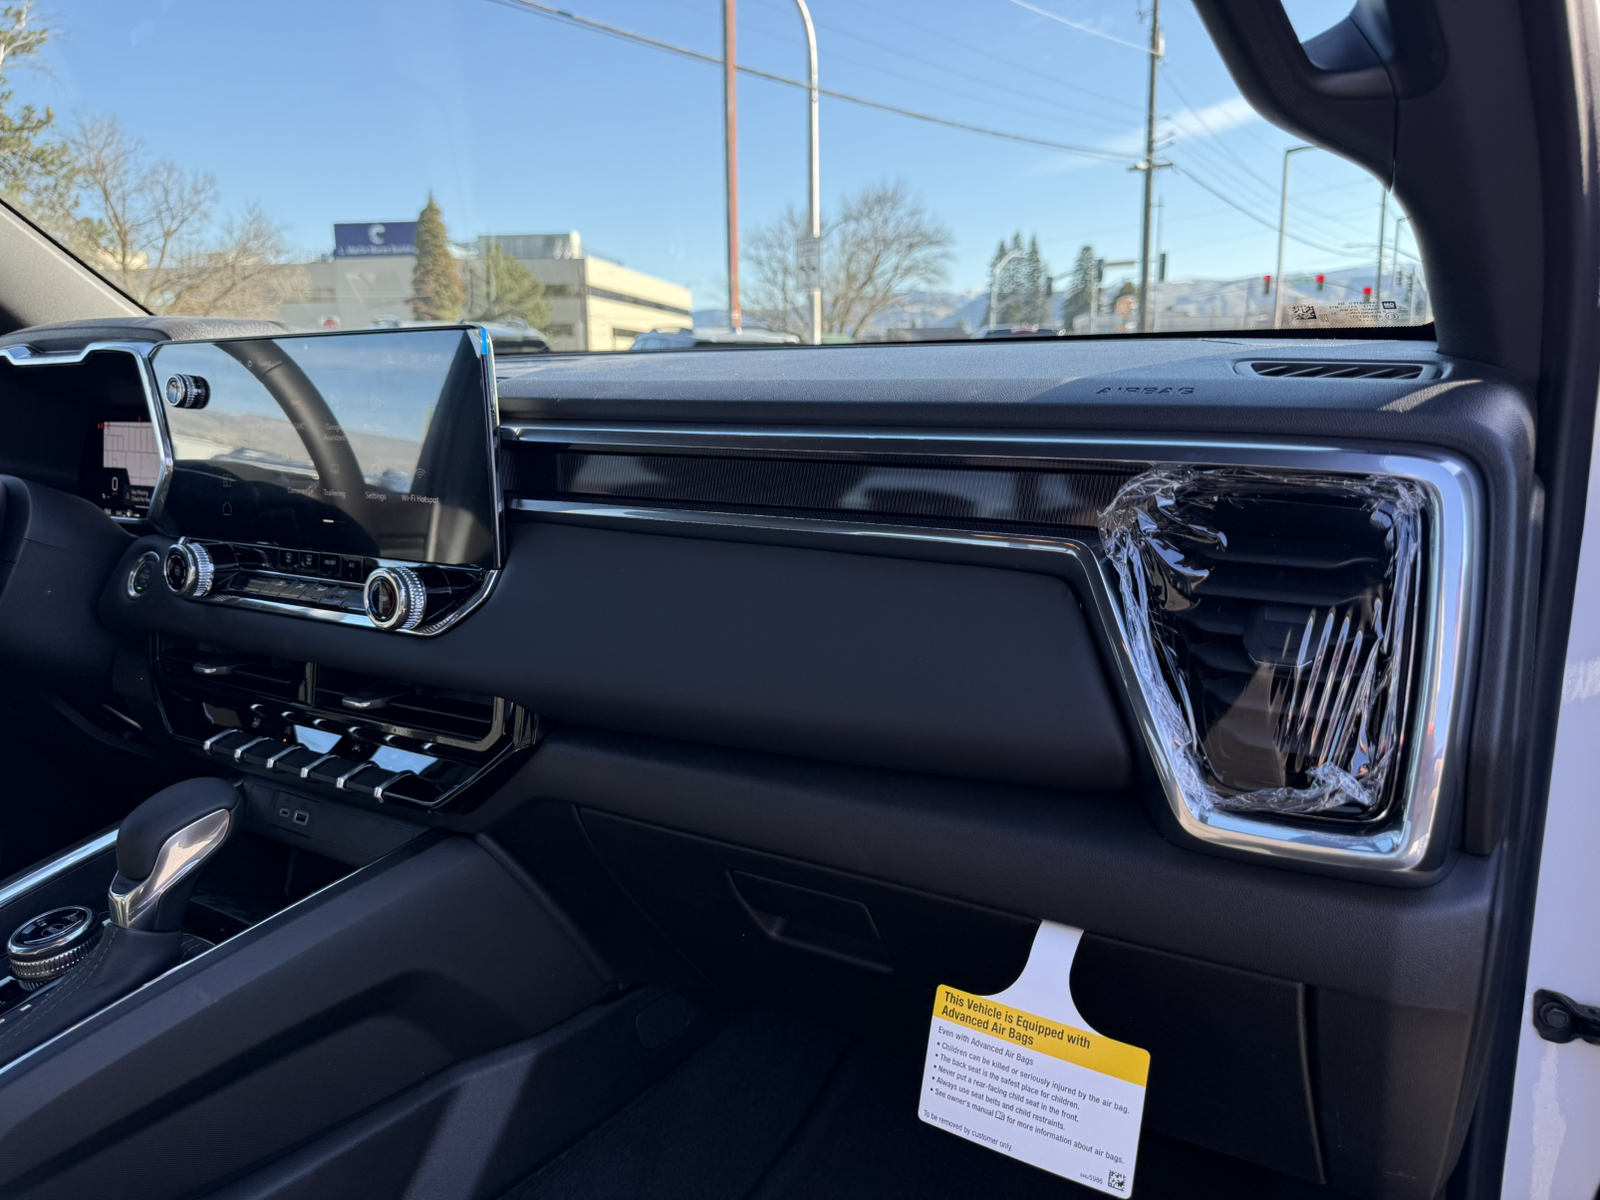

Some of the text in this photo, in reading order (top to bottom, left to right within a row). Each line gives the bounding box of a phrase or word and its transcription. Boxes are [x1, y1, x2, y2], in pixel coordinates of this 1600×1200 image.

[1096, 386, 1195, 395] AIRBAG
[324, 488, 346, 499] Trailering
[365, 491, 387, 502] Settings
[417, 495, 439, 505] Hotspot
[941, 1004, 1033, 1045] Advanced Air Bags
[944, 990, 1090, 1049] This Vehicle is Equipped with
[937, 1025, 1033, 1066] Even with Advanced Air Bags
[937, 1064, 955, 1077] Never
[955, 1072, 967, 1082] put
[972, 1078, 1007, 1098] rear-facing
[1008, 1091, 1024, 1102] child
[1025, 1098, 1039, 1108] seat
[1040, 1101, 1047, 1111] in
[1048, 1105, 1059, 1115] the
[1061, 1109, 1078, 1122] front.
[940, 1052, 1079, 1110] The back seat is the safest place for children.
[941, 1041, 1129, 1114] Children can be killed or seriously injured by the air bag.
[935, 1076, 1065, 1130] Always use seat belts and child restraints.
[923, 1108, 1012, 1151] To be removed by customer only.
[934, 1087, 1124, 1164] See owner's manual for more information about air bags.
